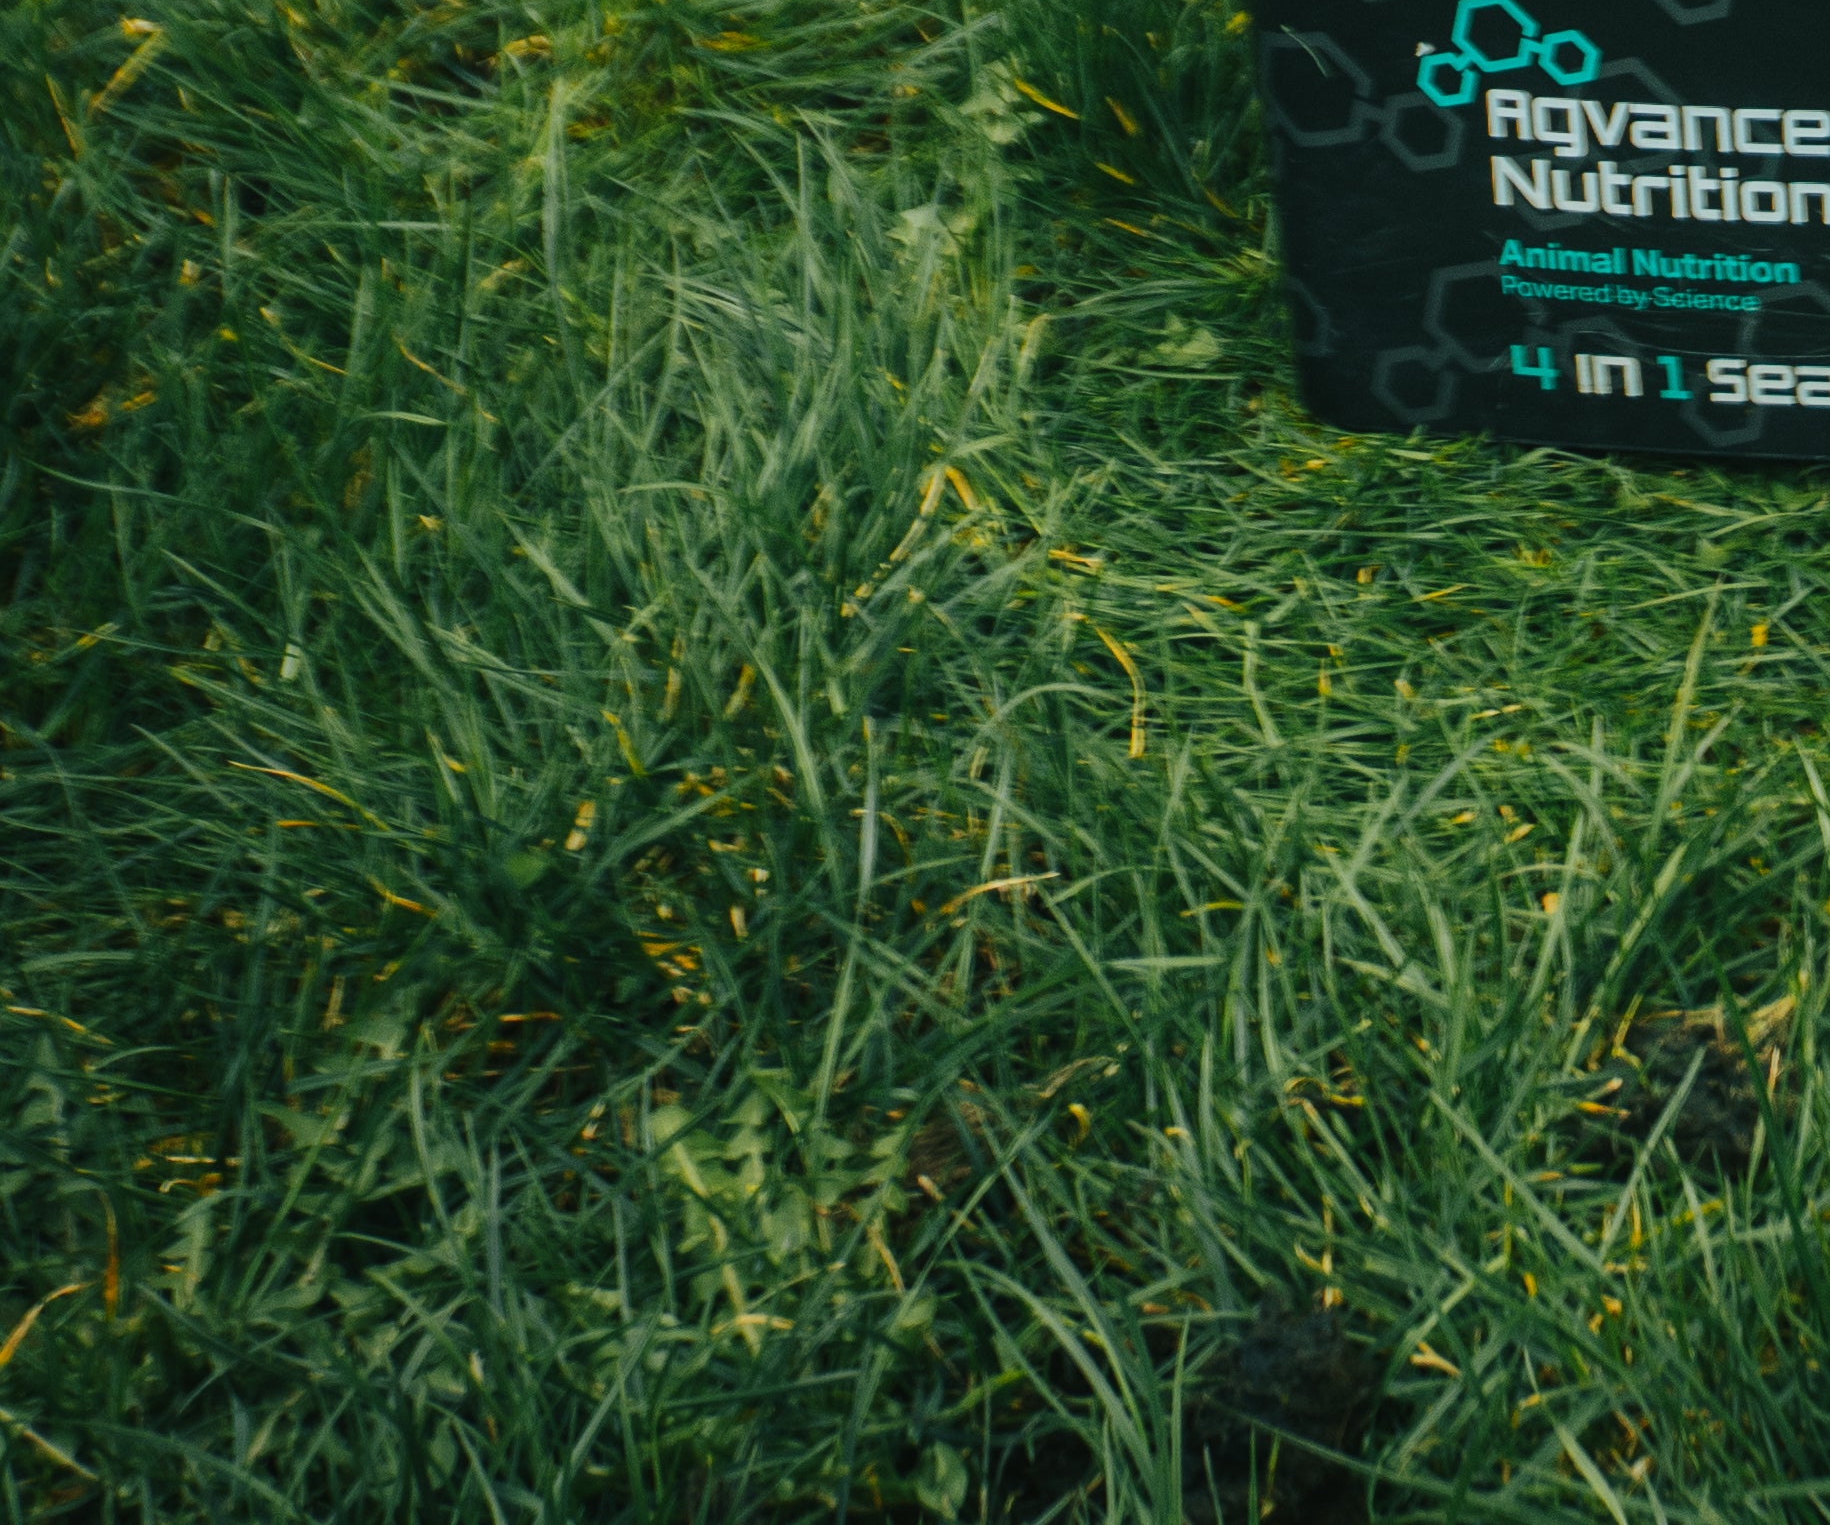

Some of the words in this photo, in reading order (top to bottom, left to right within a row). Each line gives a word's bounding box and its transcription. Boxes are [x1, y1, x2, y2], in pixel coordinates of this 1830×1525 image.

[1499, 239, 1627, 275] Animal
[1632, 248, 1800, 283] Nutrition
[1501, 275, 1610, 303] Powered
[1615, 283, 1651, 311] by
[1651, 286, 1761, 312] Science
[1510, 344, 1559, 391] 4
[1656, 355, 1694, 400] 1
